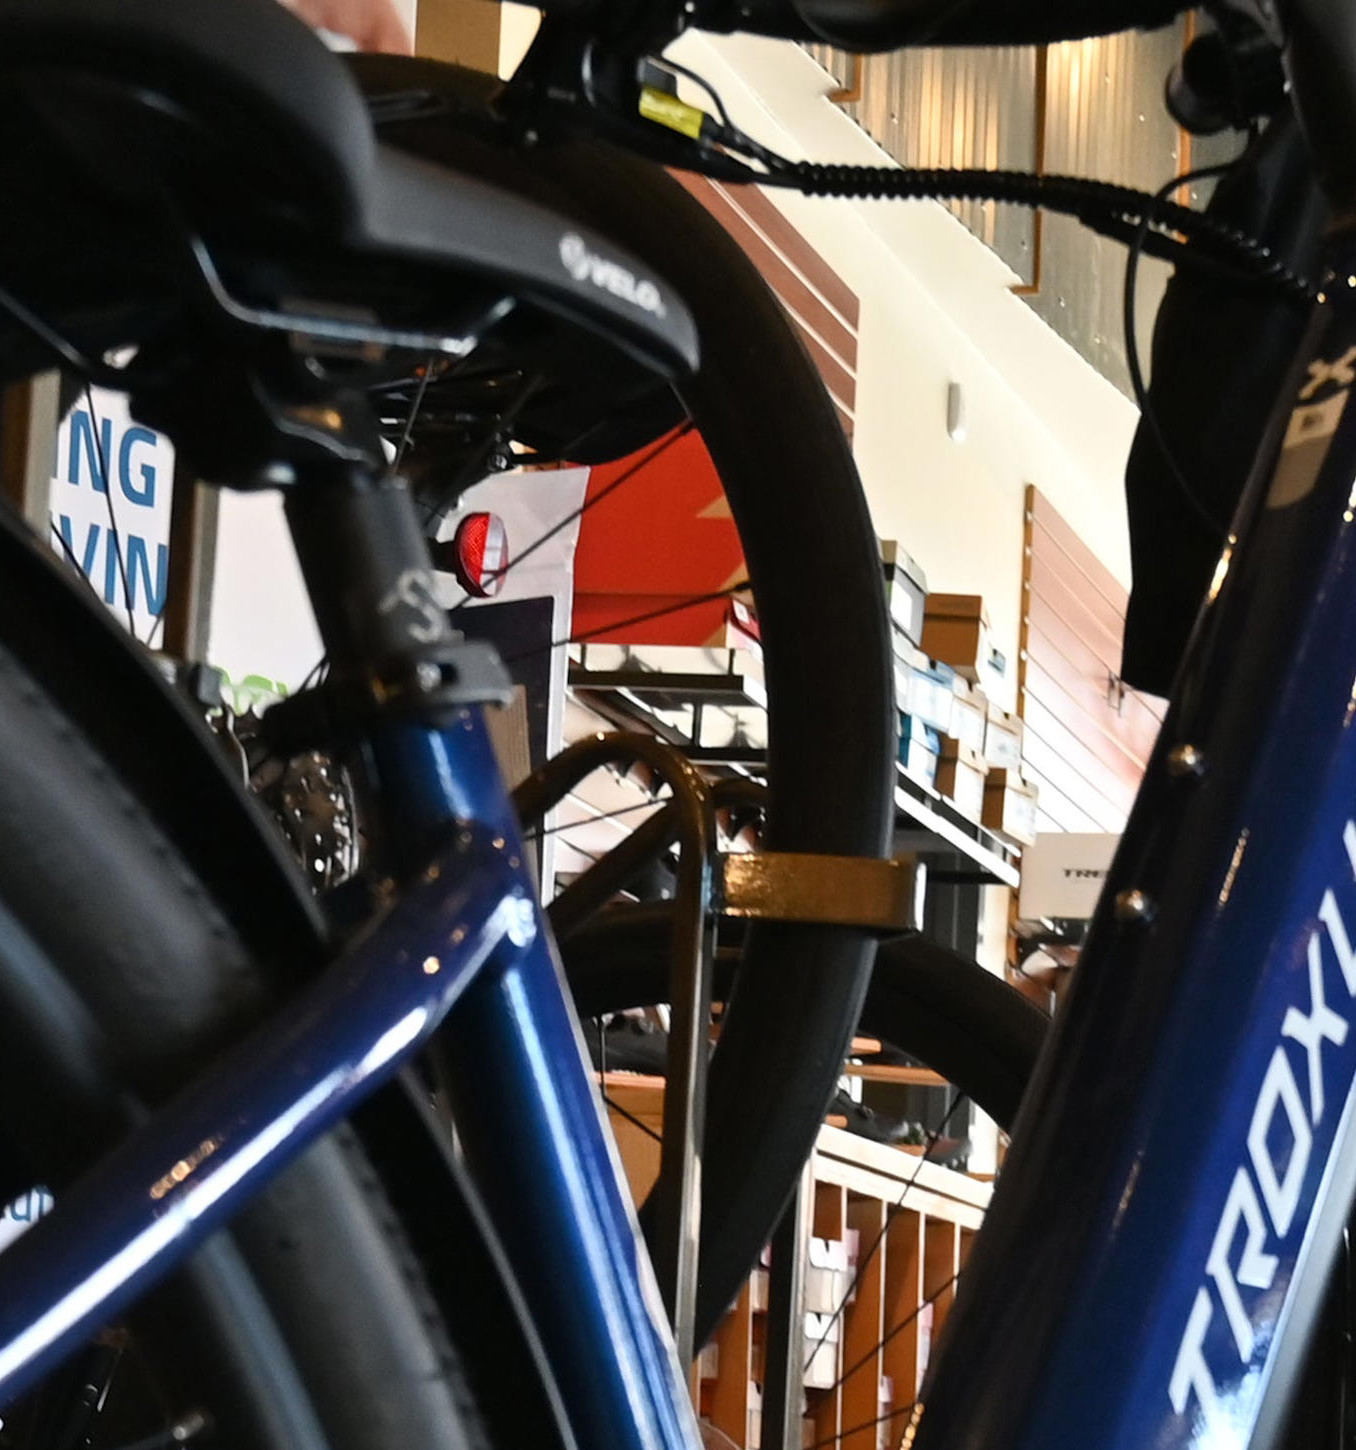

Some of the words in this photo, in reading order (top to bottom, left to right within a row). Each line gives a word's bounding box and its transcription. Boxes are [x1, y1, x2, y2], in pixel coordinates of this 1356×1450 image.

[52, 409, 158, 509] NG
[50, 513, 169, 619] VIN
[1063, 867, 1106, 879] TRE
